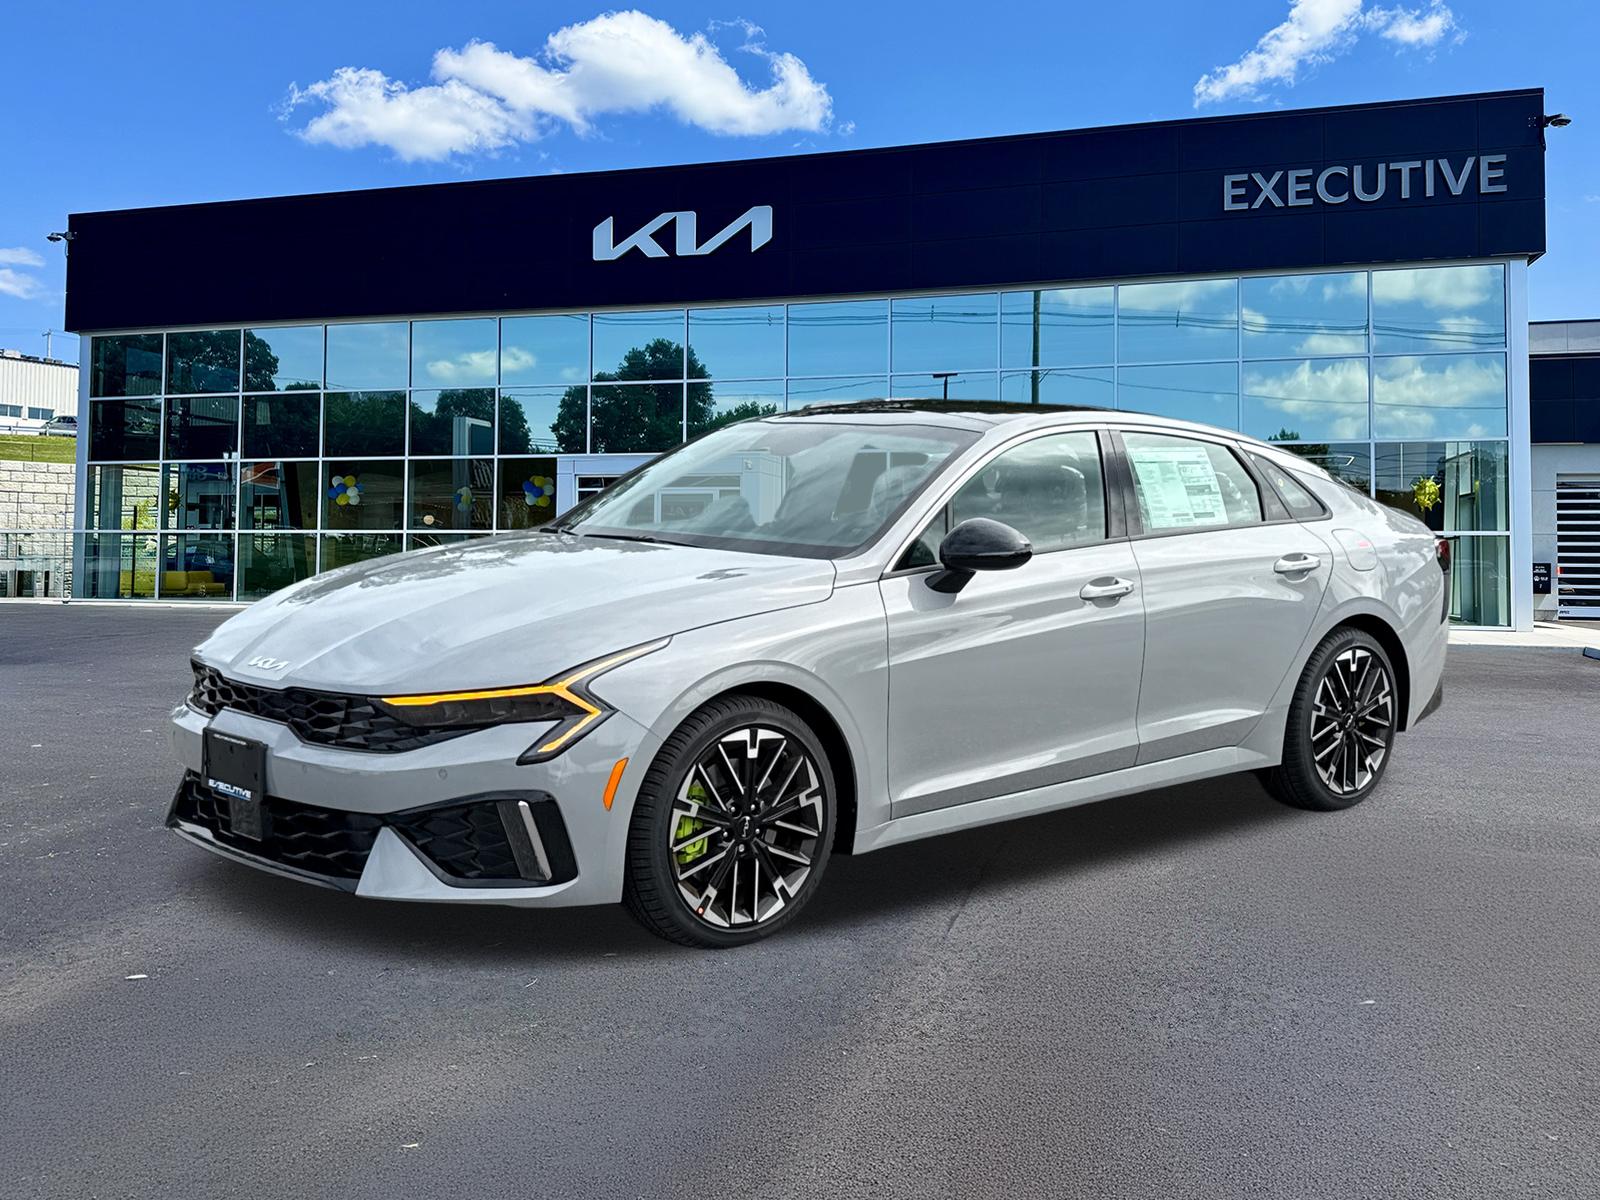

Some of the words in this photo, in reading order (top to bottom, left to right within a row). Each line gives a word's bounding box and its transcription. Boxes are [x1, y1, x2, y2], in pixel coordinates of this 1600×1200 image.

[1223, 154, 1507, 211] EXECUTIVE
[593, 205, 772, 261] KIA
[248, 656, 288, 670] KIA
[208, 779, 252, 799] EXECUTIVE
